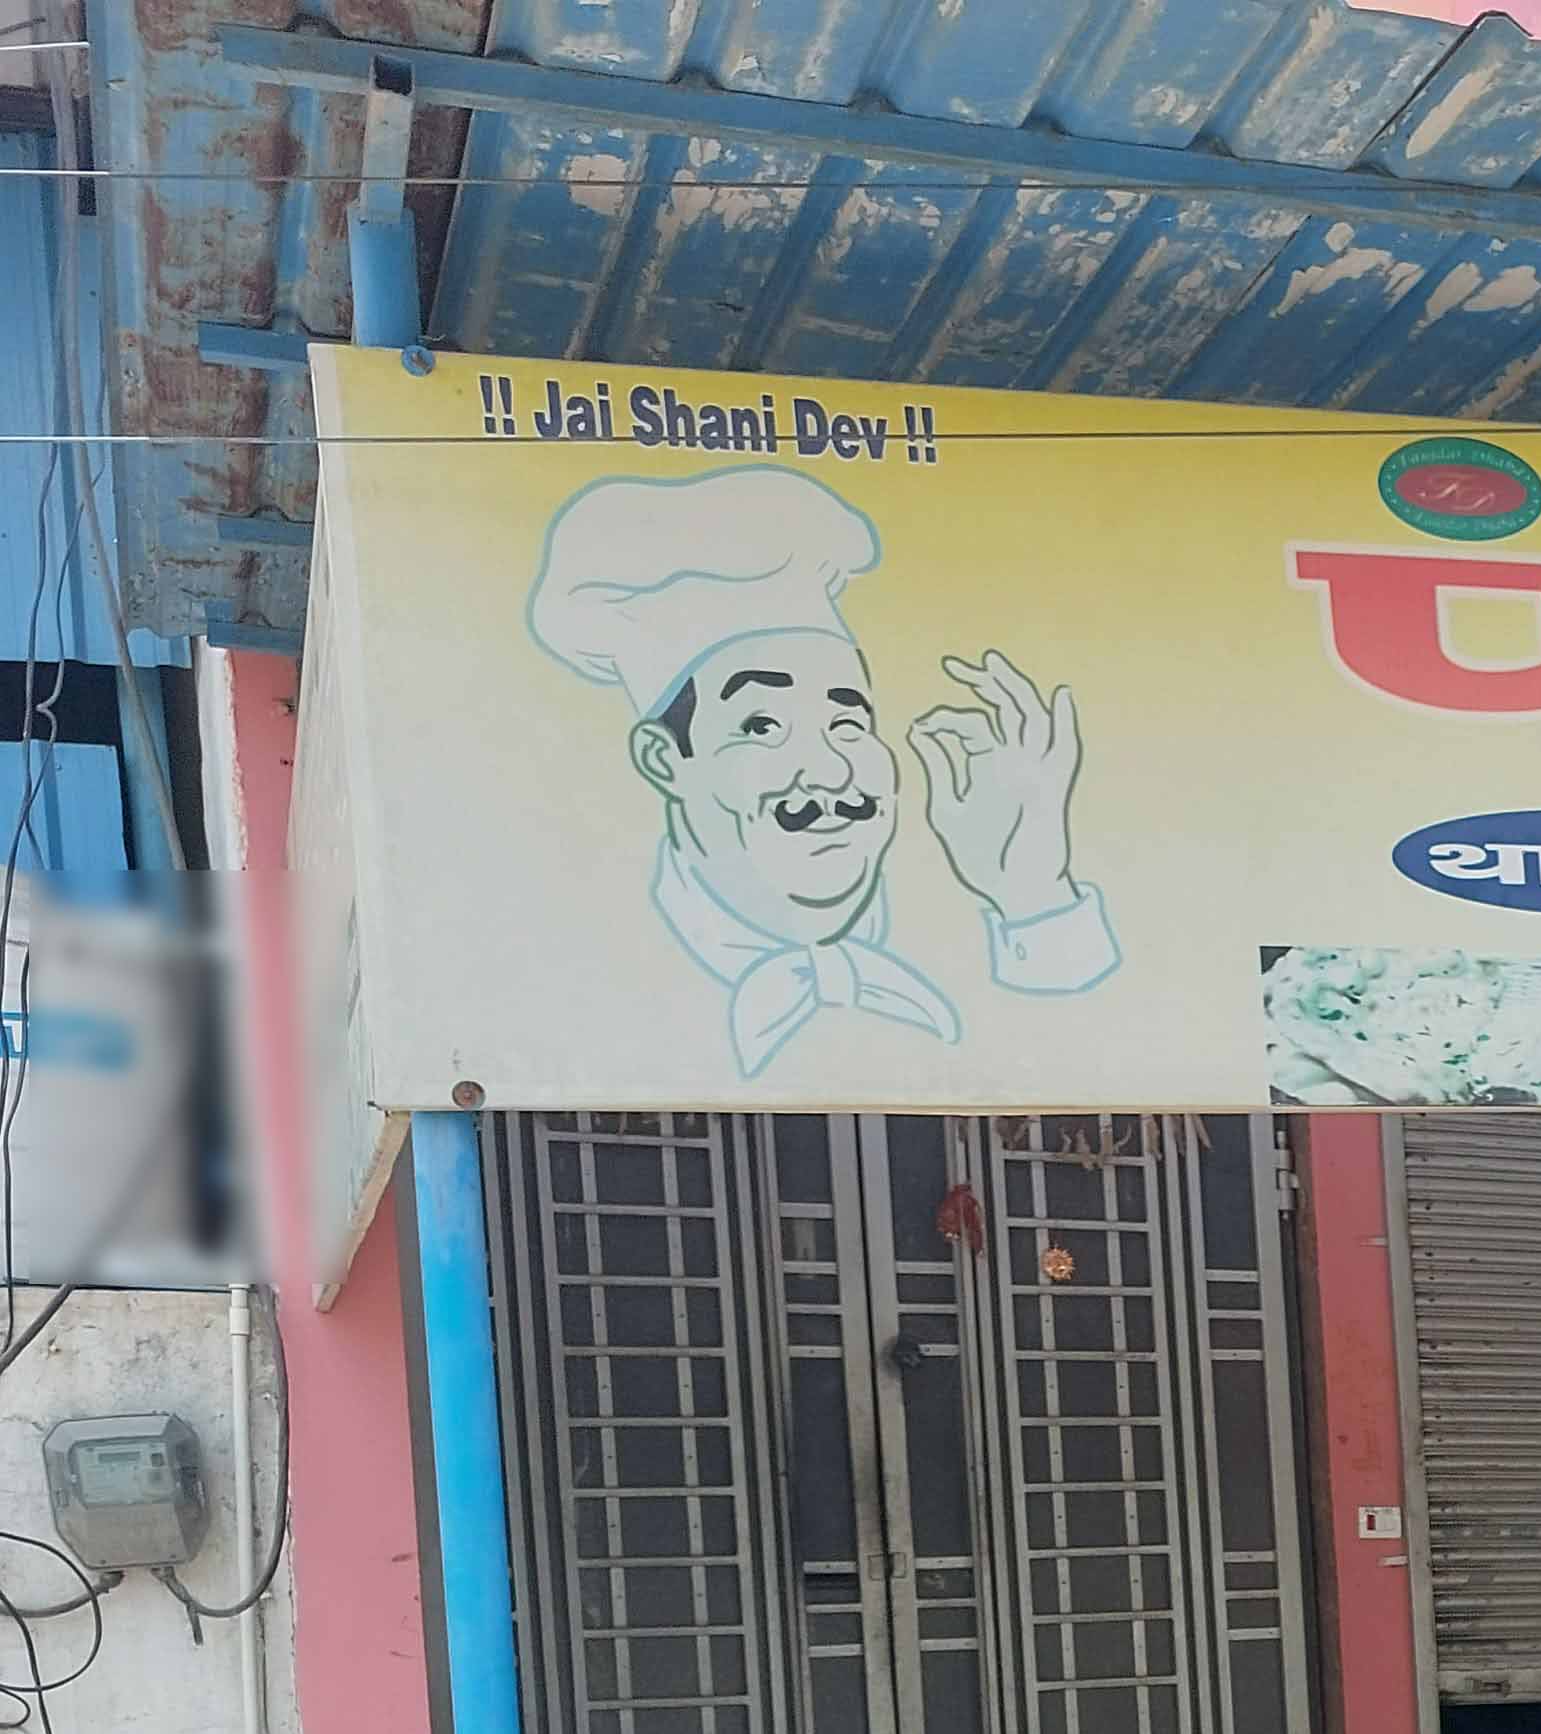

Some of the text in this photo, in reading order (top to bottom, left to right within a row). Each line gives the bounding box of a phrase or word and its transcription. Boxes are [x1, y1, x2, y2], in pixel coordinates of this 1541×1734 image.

[533, 380, 613, 440] Jai
[629, 384, 778, 454] Shani
[794, 397, 888, 460] Dev
